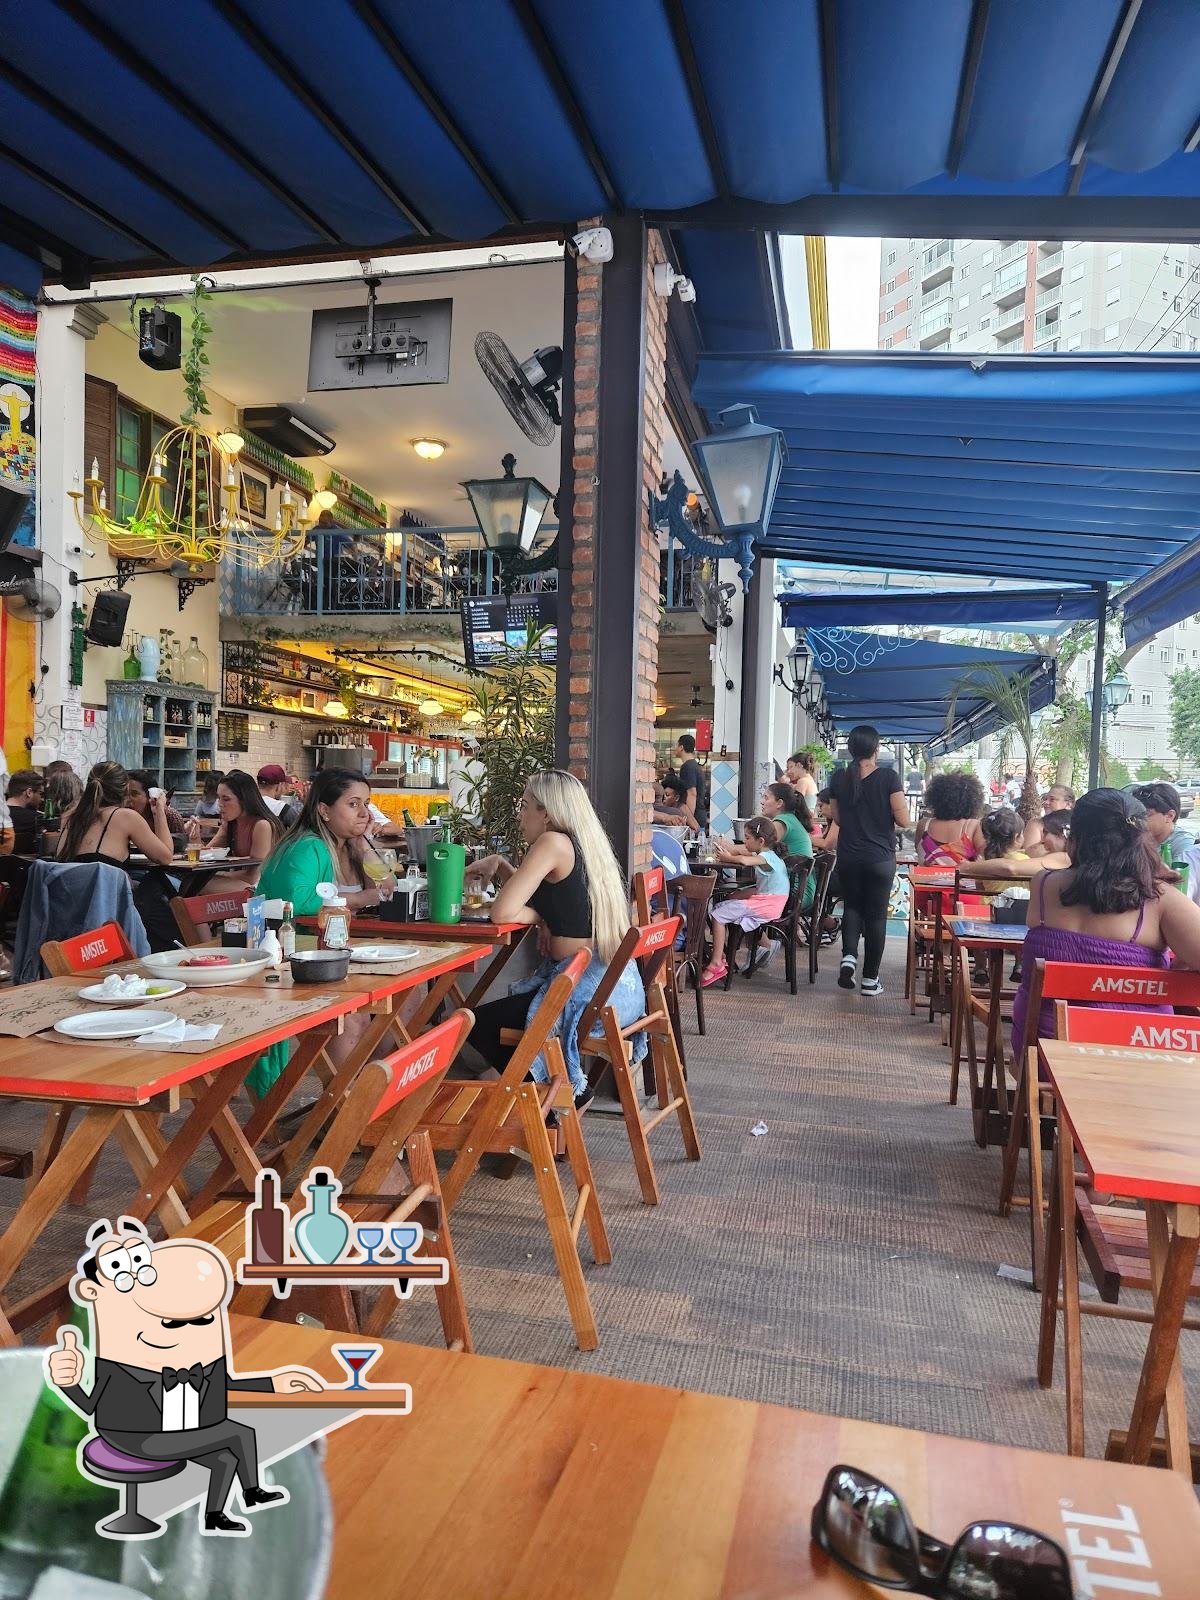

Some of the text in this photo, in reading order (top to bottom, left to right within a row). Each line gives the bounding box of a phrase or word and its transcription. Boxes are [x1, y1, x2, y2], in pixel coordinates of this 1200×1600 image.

[207, 900, 239, 915] AMSTEL
[644, 930, 666, 947] AMSTEL
[79, 938, 109, 963] AMSTEL
[1091, 976, 1168, 996] AMSTEL
[396, 1046, 439, 1092] AMSTEL
